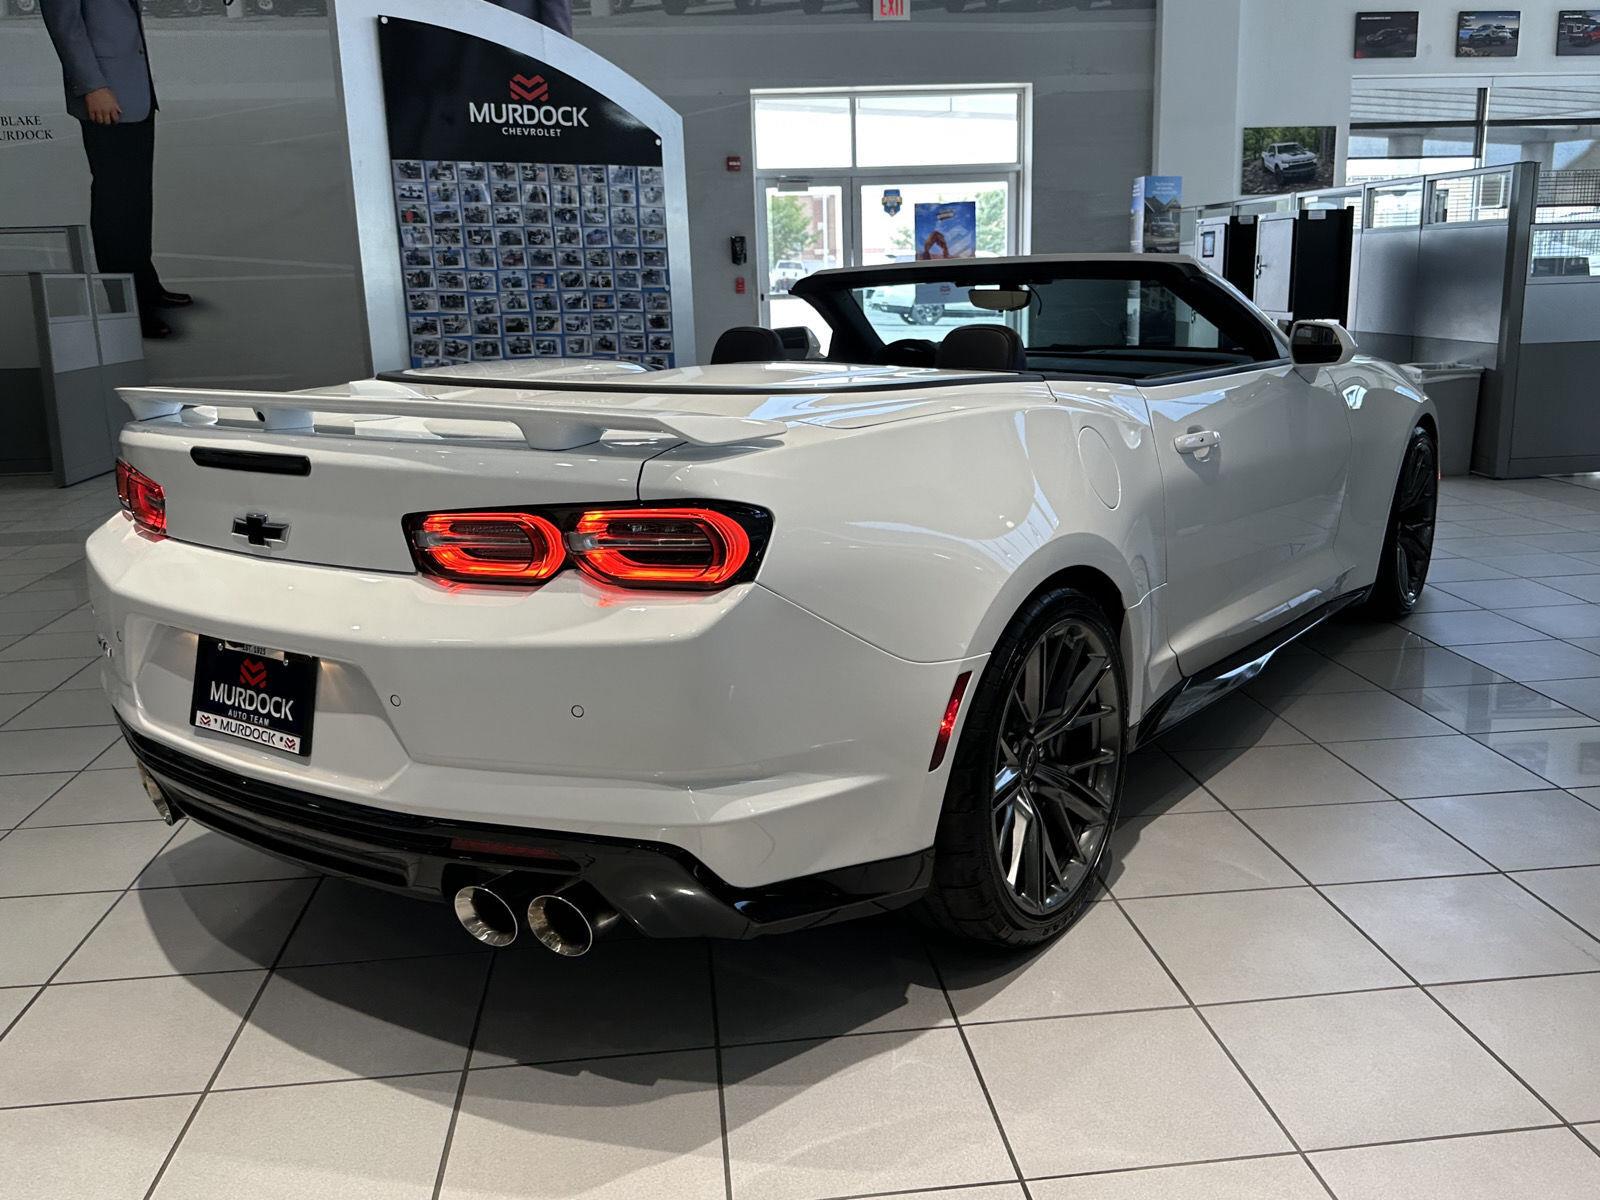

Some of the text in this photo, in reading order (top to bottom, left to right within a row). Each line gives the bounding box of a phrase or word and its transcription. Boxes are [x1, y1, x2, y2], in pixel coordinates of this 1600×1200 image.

[0, 115, 42, 126] BLAKE
[469, 102, 589, 127] MURDOCK
[501, 127, 562, 137] CHEVROLET
[210, 681, 294, 721] MURDOCK
[228, 709, 269, 726] AUTO TEAM
[220, 718, 276, 745] MURDOCK
